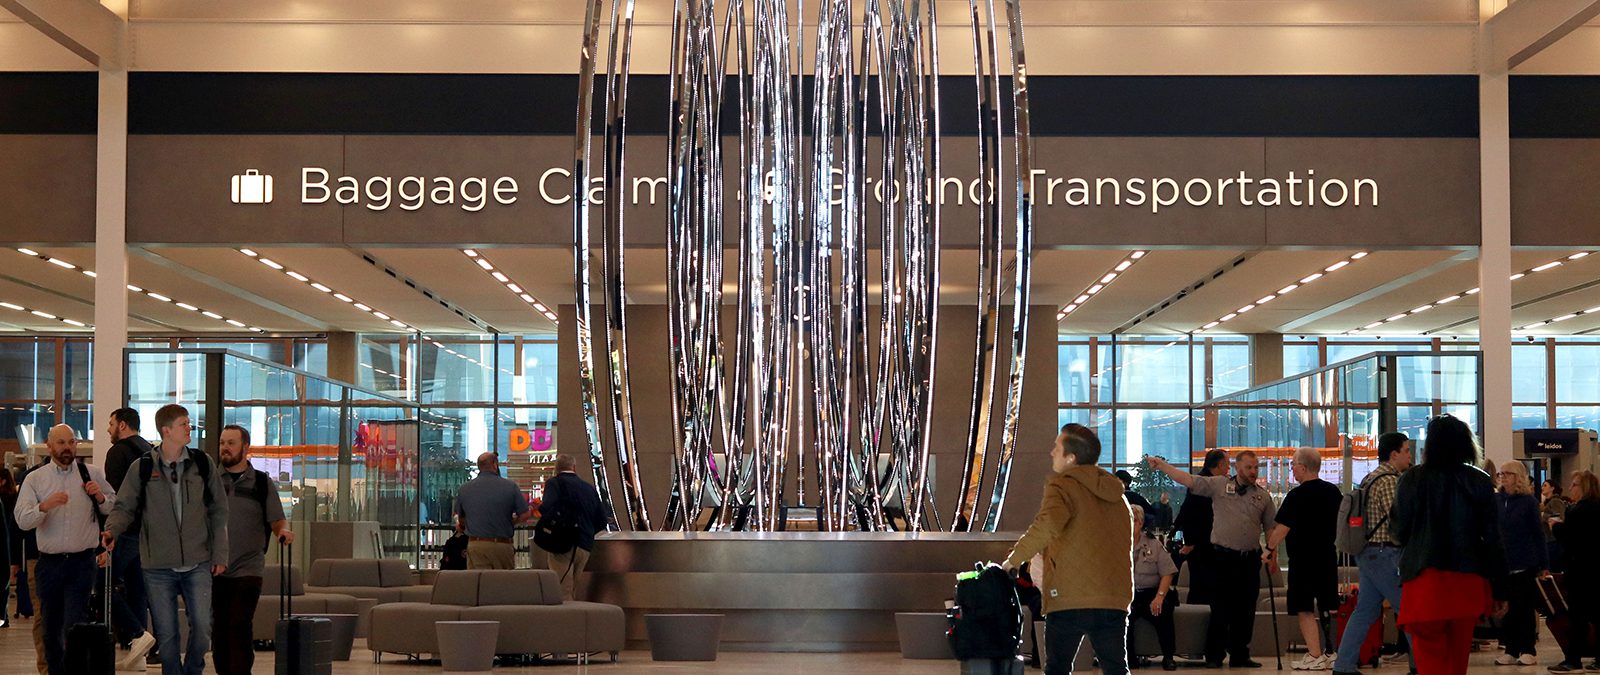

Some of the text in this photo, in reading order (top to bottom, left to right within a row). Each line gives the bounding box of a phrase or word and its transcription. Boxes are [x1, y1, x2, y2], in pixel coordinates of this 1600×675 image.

[300, 166, 668, 211] Baggage Cam
[831, 167, 1380, 213] ond Transportation
[1544, 442, 1563, 450] leidos
